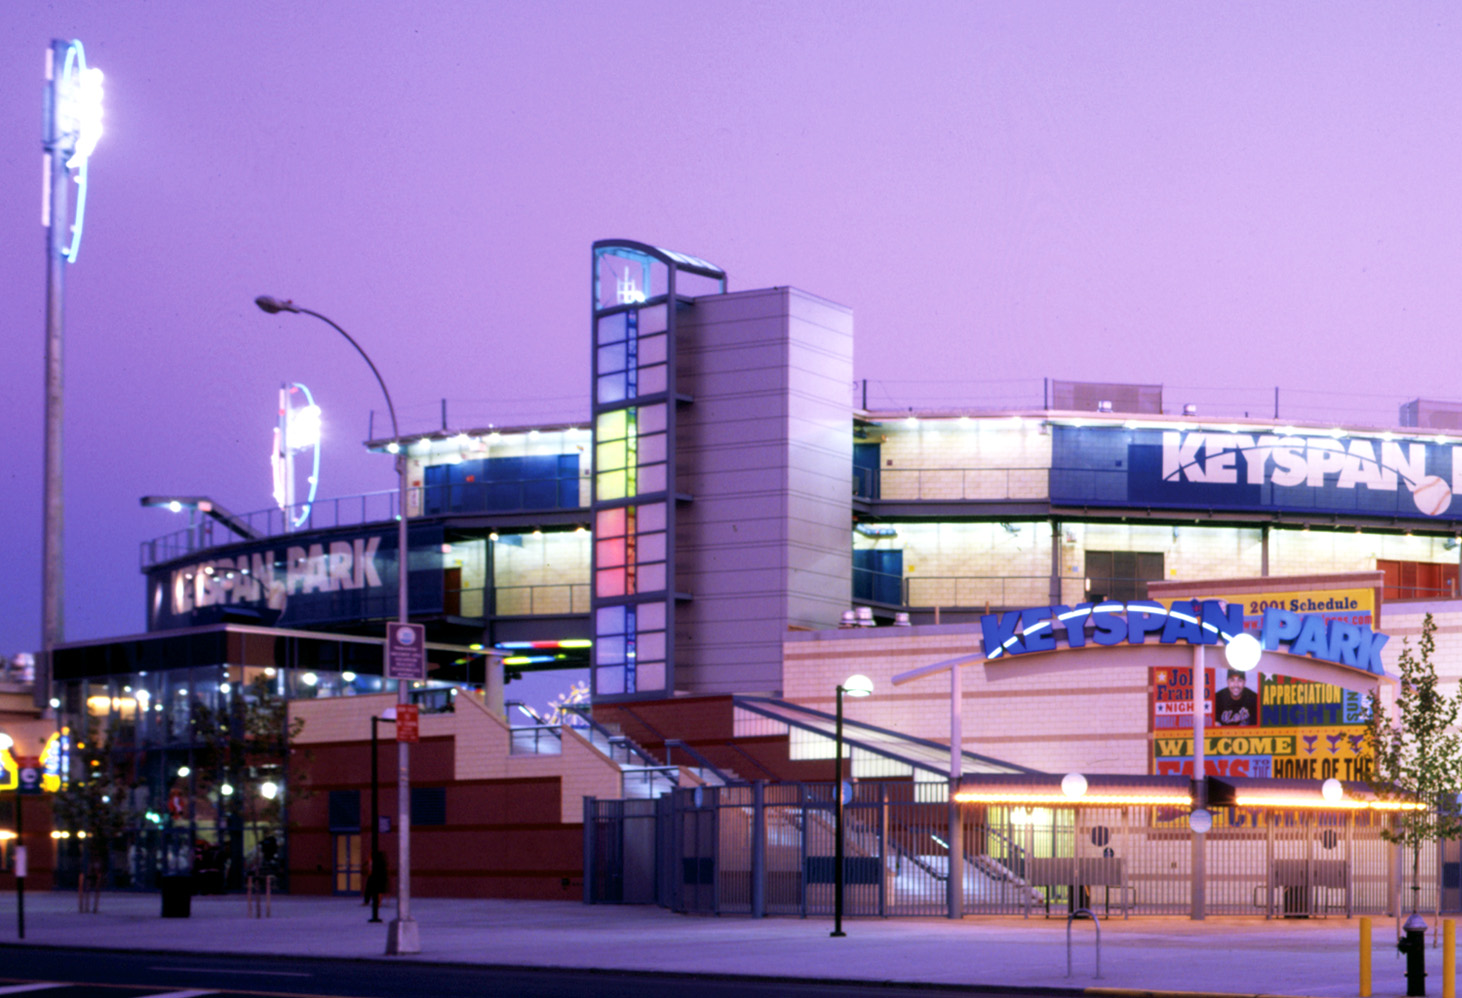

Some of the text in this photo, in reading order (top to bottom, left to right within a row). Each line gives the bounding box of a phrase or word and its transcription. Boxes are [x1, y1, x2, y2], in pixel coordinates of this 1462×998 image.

[1163, 431, 1426, 492] KEYSPAN
[287, 537, 382, 595] PARK
[1250, 597, 1358, 613] 2001 Schedule
[980, 600, 1390, 676] KEYSPAN PARK
[1157, 685, 1210, 700] Frano
[1263, 683, 1341, 705] APPRECIATION
[1165, 702, 1195, 712] NIGH
[1262, 703, 1342, 725] NIGHT
[1157, 759, 1250, 779] FANS
[1274, 758, 1317, 779] HOME
[1322, 758, 1339, 779] OF
